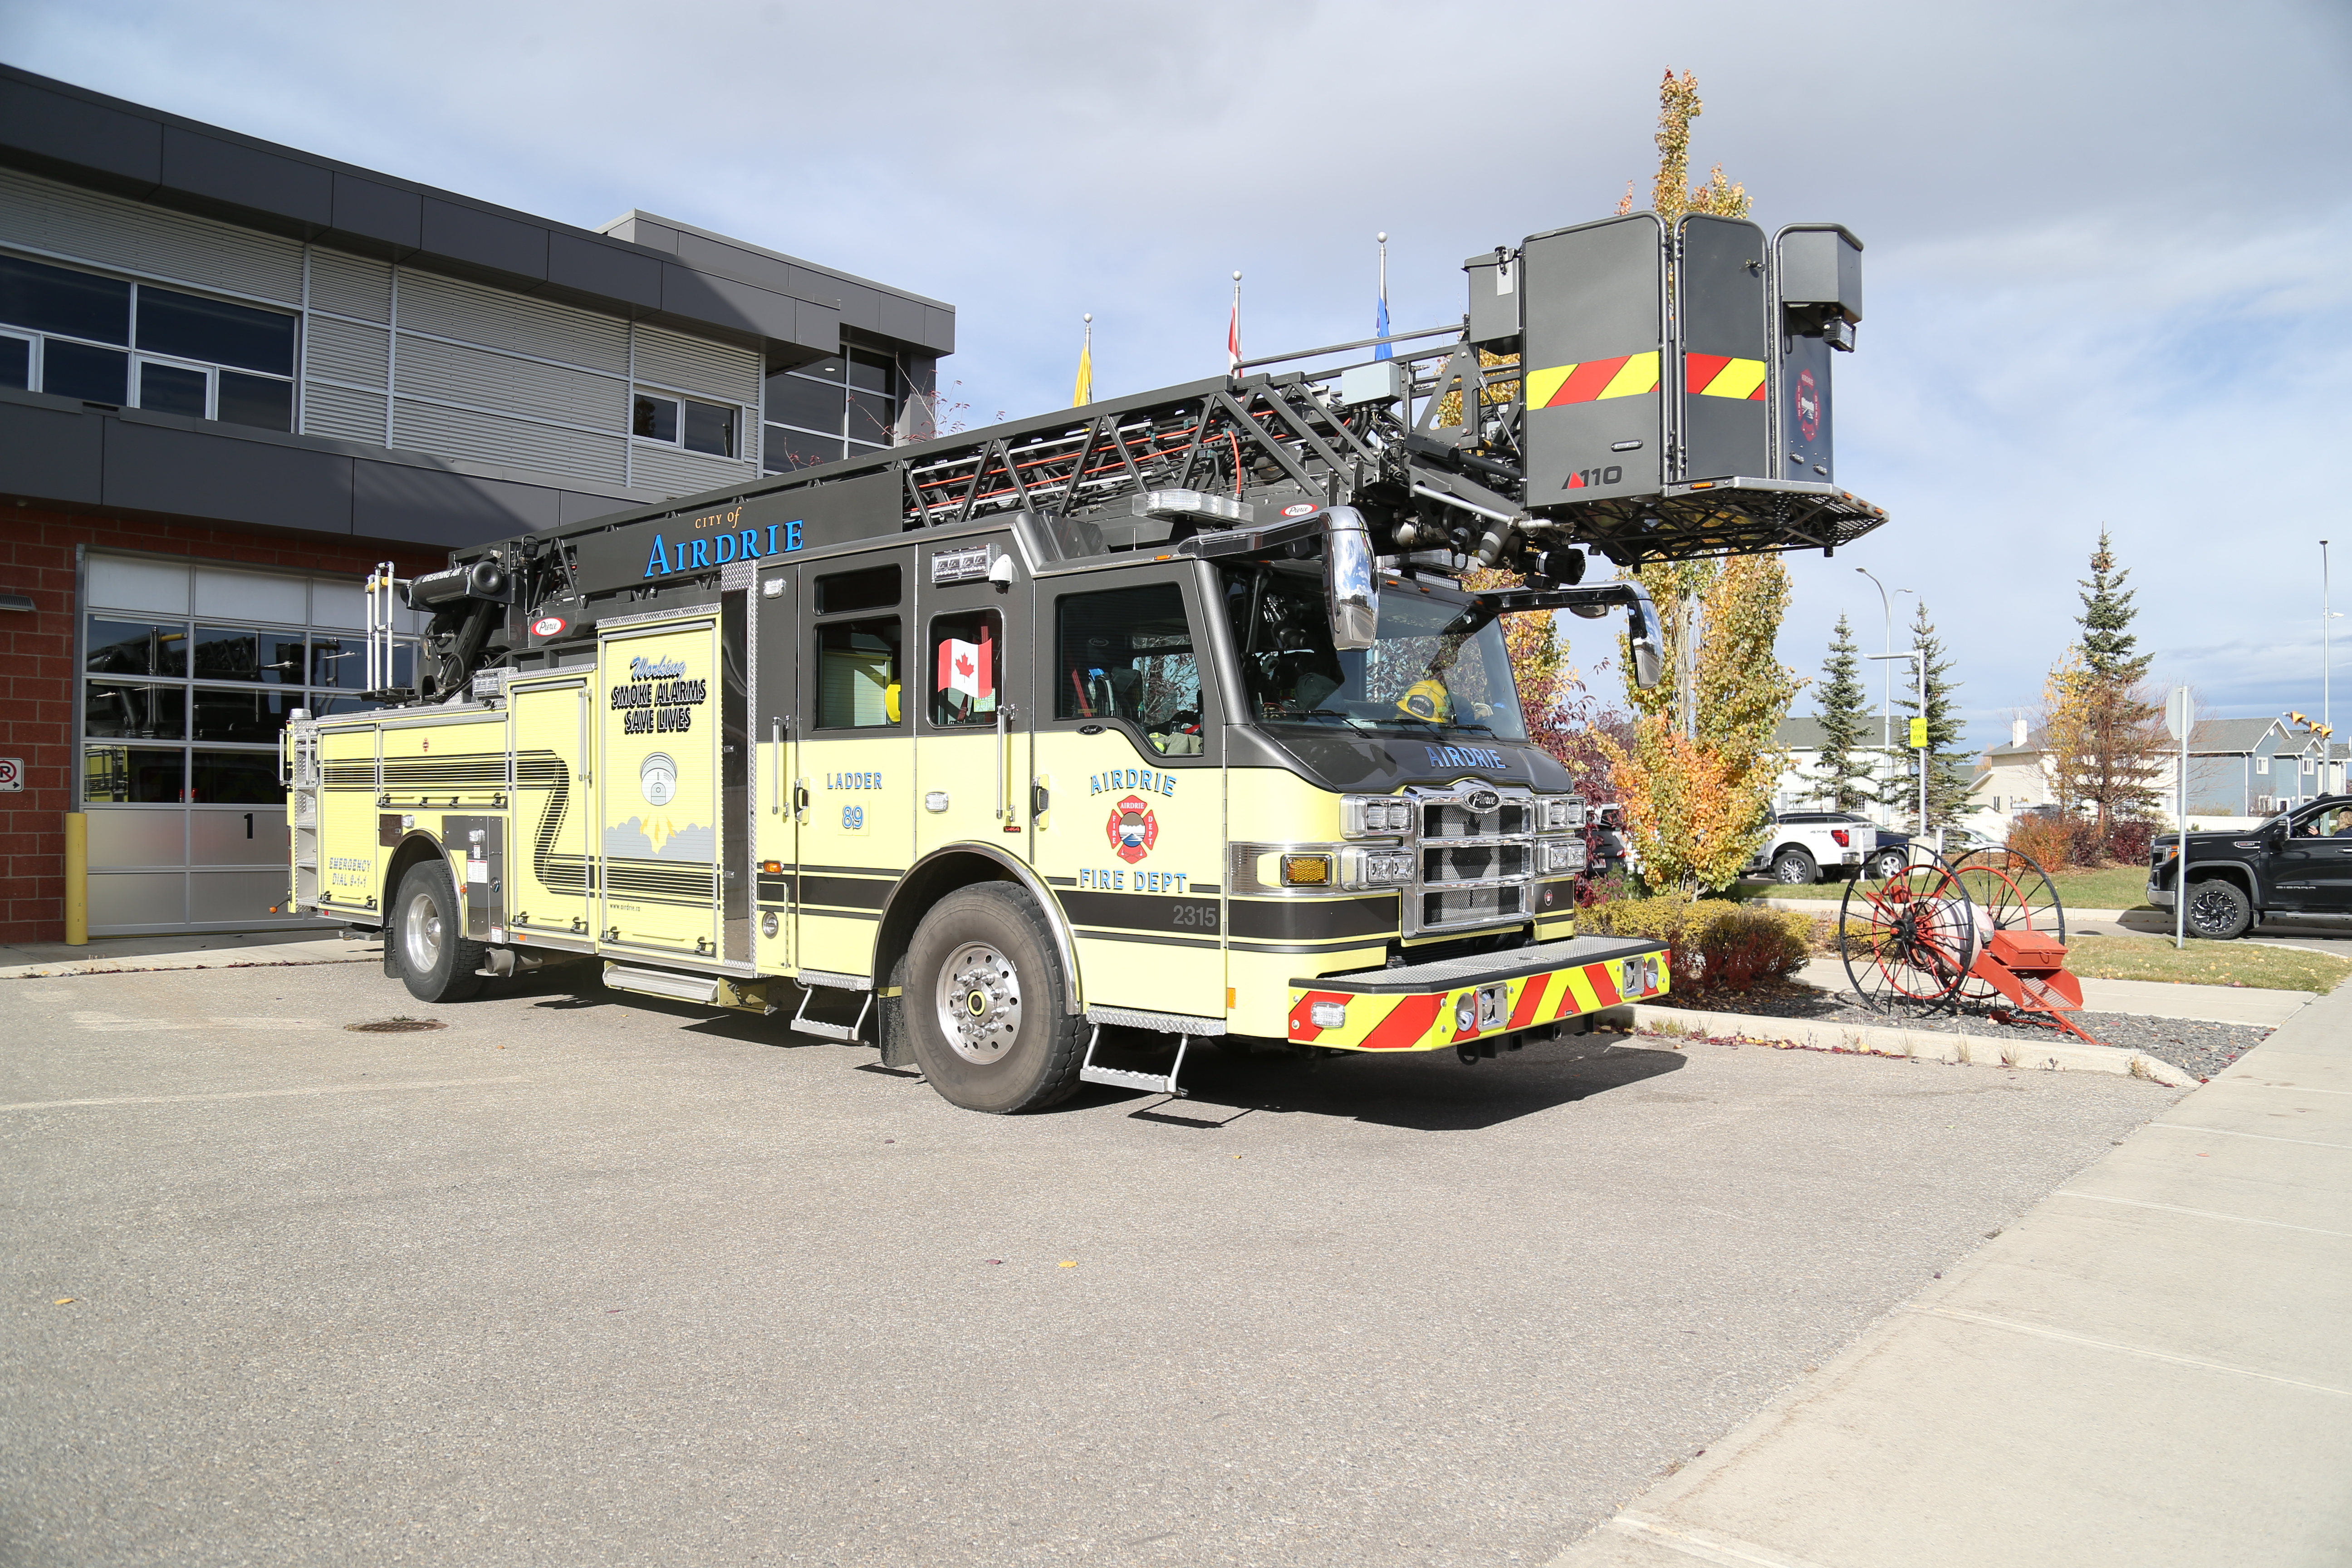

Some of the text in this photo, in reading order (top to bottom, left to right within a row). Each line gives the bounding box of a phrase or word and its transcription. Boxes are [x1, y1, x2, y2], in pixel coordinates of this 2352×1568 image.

[695, 506, 742, 529] CITY of
[1289, 506, 1309, 515] Pierce
[421, 568, 463, 583] BREATHING AIR
[539, 621, 557, 633] Pierce
[630, 654, 687, 682] Working
[611, 678, 706, 710] SMOKE ALARMS
[624, 706, 691, 735] SAVE LIVES
[1424, 746, 1506, 769] AIRDRIE
[827, 772, 882, 789] LADDER
[1090, 768, 1177, 797] AIRDRIE
[1472, 792, 1496, 807] Pierce
[244, 813, 254, 839] 1
[842, 805, 864, 829] 89
[329, 857, 372, 872] EMERGENCY
[332, 873, 367, 888] DIAL 9-1-1
[1080, 868, 1187, 892] FIRE DEPT
[609, 903, 640, 912] www.airdrie.ca
[1173, 905, 1216, 927] 2315
